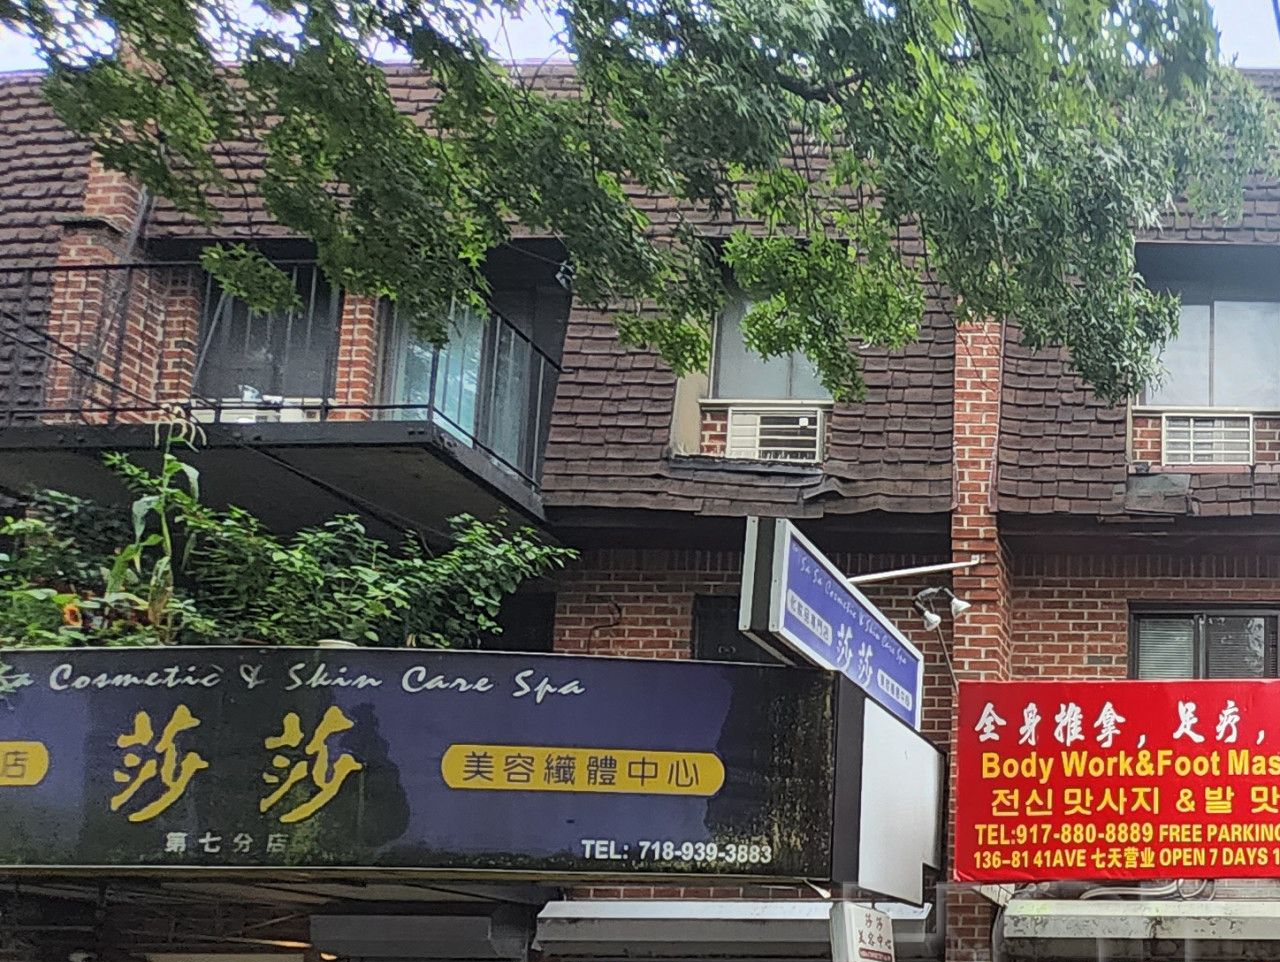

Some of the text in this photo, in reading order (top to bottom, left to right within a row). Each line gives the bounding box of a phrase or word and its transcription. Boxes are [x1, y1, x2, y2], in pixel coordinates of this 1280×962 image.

[49, 664, 223, 692] Cosmetic
[239, 664, 266, 688] &
[285, 664, 382, 691] Skin
[402, 666, 494, 693] Care
[513, 669, 585, 703] Spa
[110, 704, 363, 823] 莎莎
[982, 751, 1054, 784] Body
[1061, 749, 1219, 778] Work&Foot
[991, 788, 1054, 818] 전신
[1064, 787, 1159, 815] 맛사지
[1176, 789, 1196, 812] &
[1205, 786, 1234, 813] 발
[165, 832, 291, 854] 第七分店
[975, 823, 1154, 846] TEL:917-880-8889
[1159, 824, 1202, 842] FREE
[581, 839, 772, 865] TEL: 718-939-3883
[973, 850, 1029, 869] 136-81
[1033, 849, 1086, 868] 41AVE
[1091, 847, 1156, 869] 七天营业
[1160, 848, 1205, 867] OPEN
[1209, 849, 1219, 866] 7
[1222, 848, 1268, 867] DAYS
